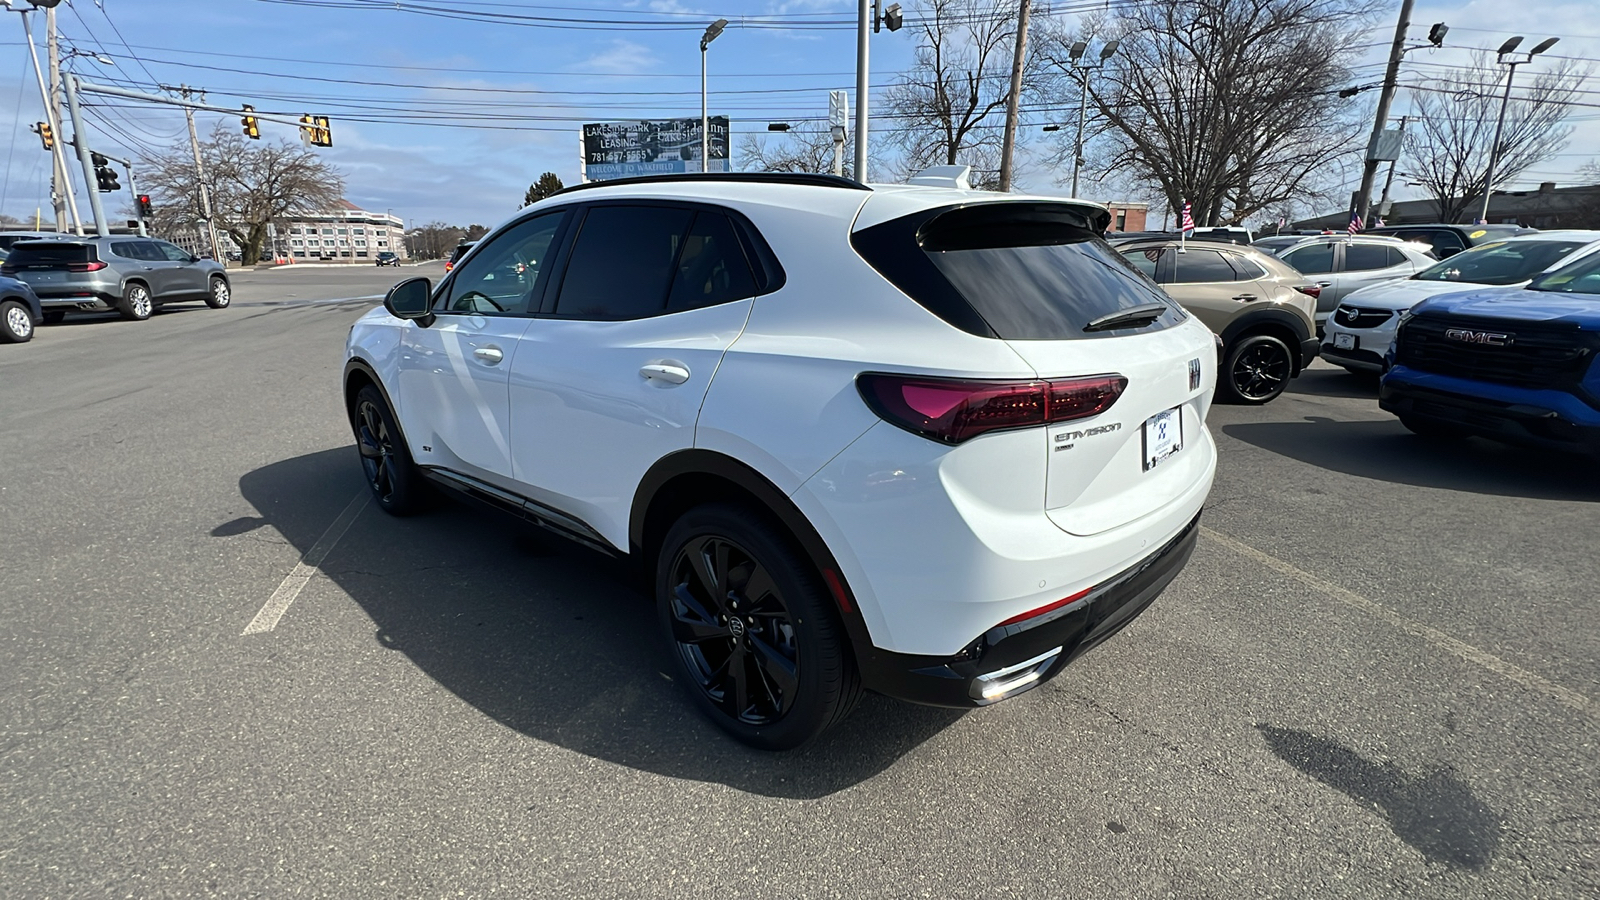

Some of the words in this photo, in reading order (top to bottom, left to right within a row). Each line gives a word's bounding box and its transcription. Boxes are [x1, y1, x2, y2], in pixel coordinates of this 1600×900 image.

[586, 126, 625, 137] LAKESIDE
[627, 124, 650, 133] PARK
[672, 121, 687, 132] The
[600, 138, 636, 149] LEASING
[590, 164, 620, 174] WELCOME
[637, 162, 674, 171] WAKEFIELD
[1445, 329, 1508, 346] GMC
[1054, 422, 1122, 443] ENVISION
